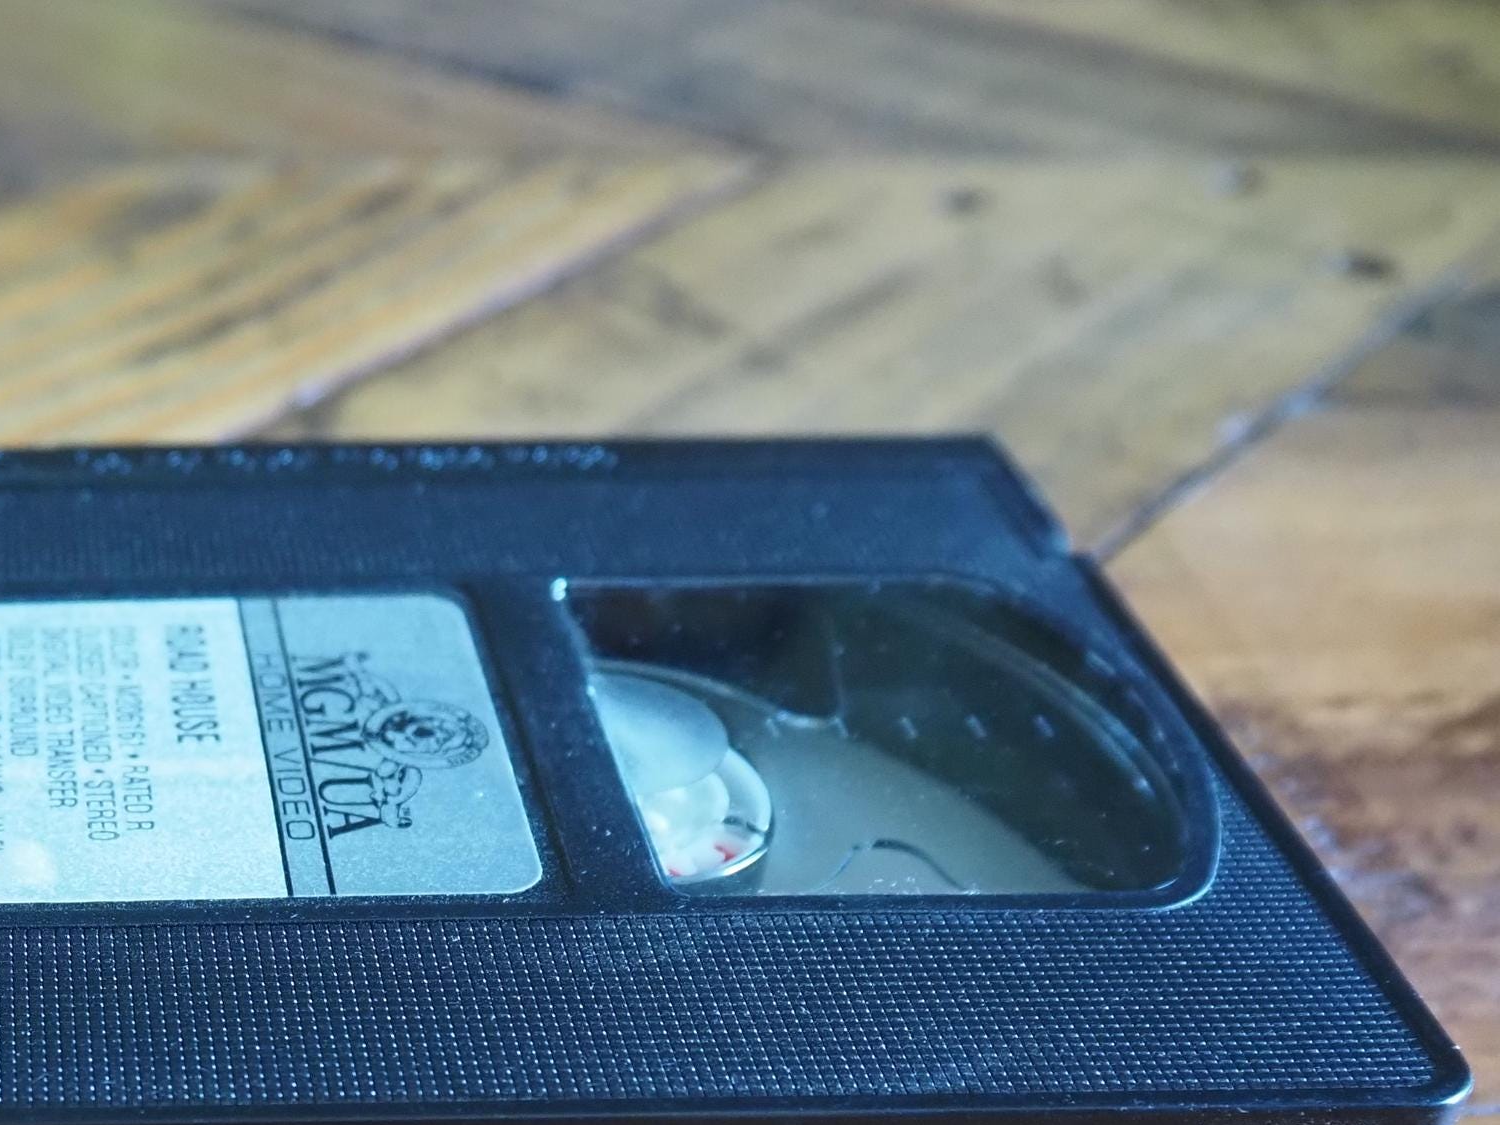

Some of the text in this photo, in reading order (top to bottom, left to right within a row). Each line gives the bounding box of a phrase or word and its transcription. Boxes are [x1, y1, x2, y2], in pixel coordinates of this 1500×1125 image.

[8, 675, 37, 756] SURROUND
[77, 683, 113, 764] CAPTIONED
[170, 680, 220, 743] HOUSE
[254, 652, 315, 840] HOME VIDEO
[290, 653, 384, 839] MGM/UA
[44, 729, 79, 809] TRANSFER
[120, 765, 154, 813] RATED
[84, 778, 119, 841] STEREO
[125, 820, 156, 831] R
